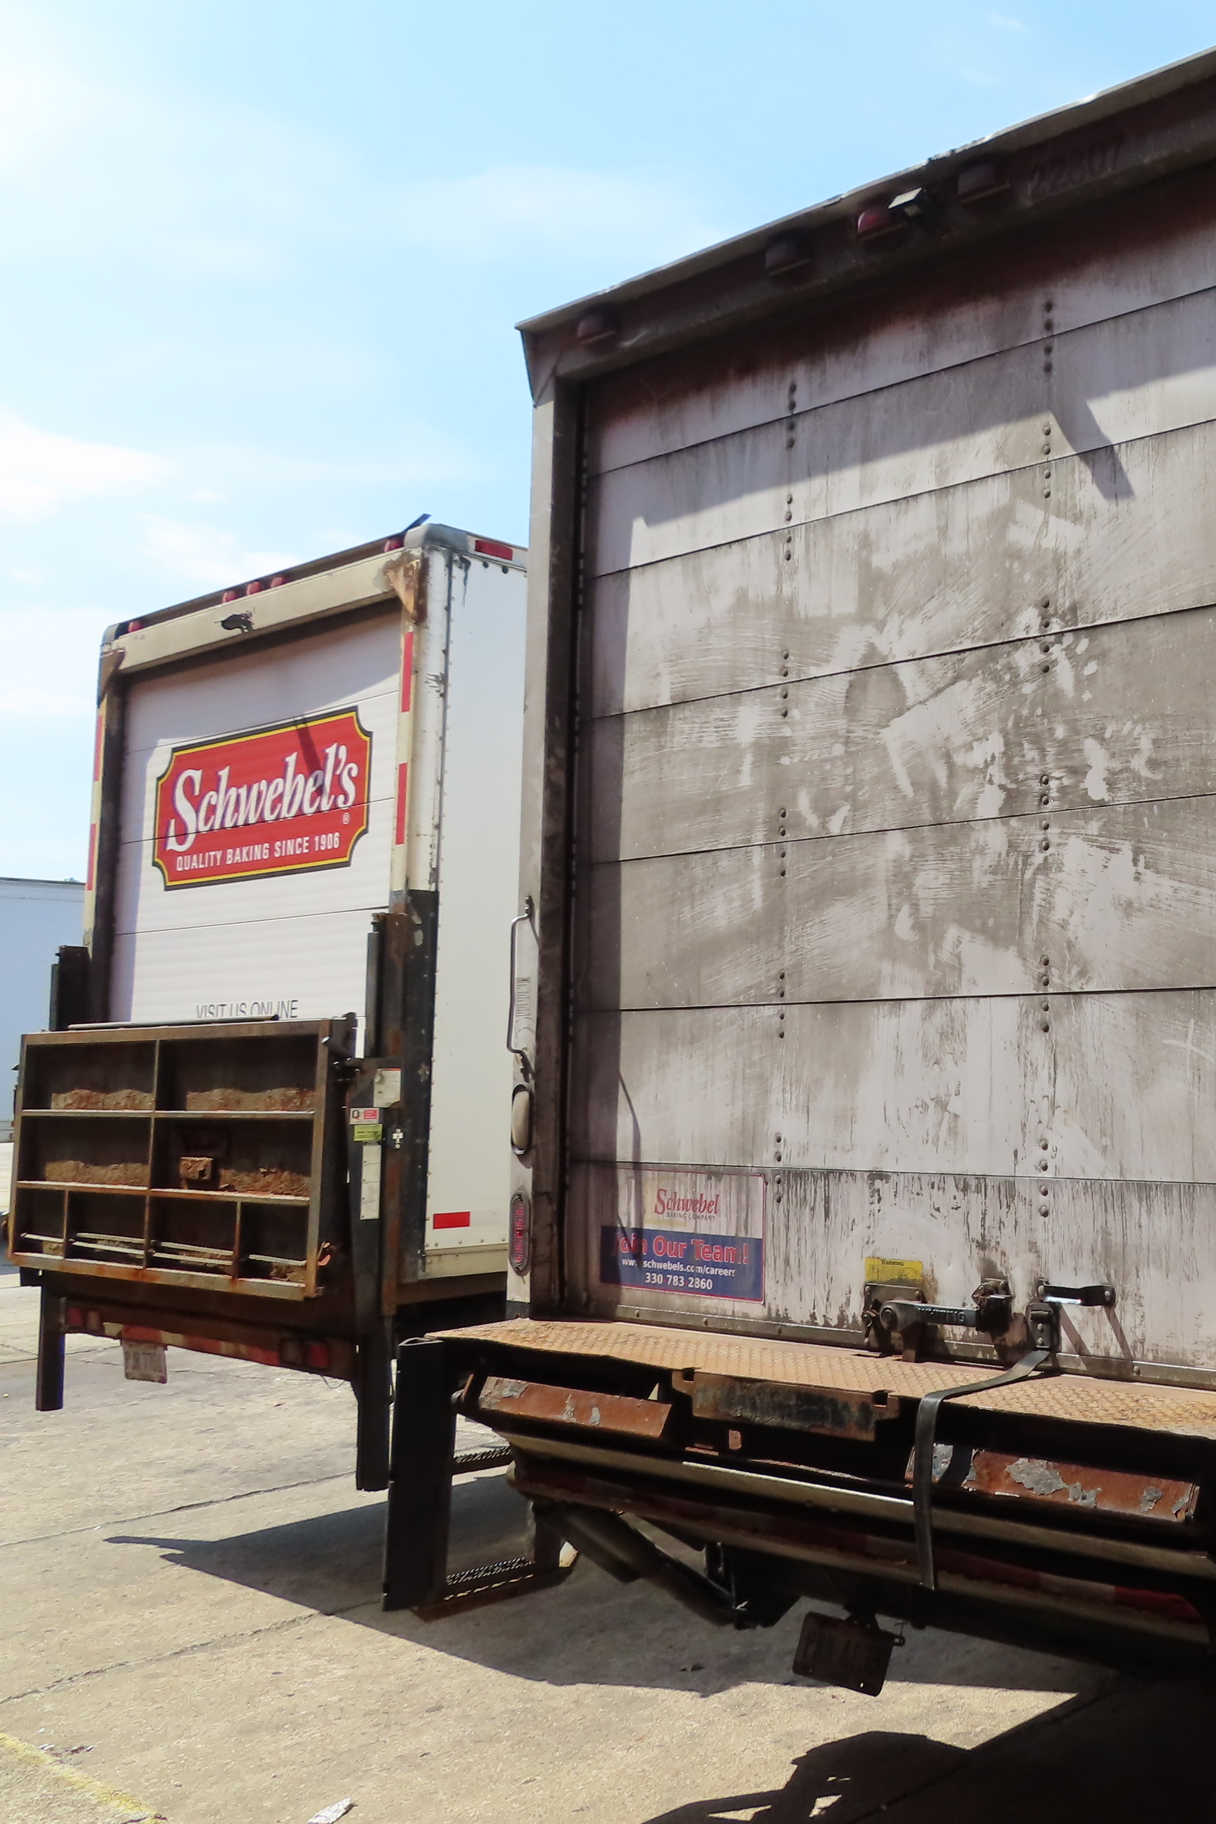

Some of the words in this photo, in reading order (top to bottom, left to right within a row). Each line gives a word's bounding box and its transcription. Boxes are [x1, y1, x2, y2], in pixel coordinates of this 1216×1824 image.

[165, 742, 359, 853] Schwebel's
[176, 852, 223, 872] QUALITY
[226, 843, 270, 865] BAKING
[274, 836, 310, 858] SINCE
[314, 832, 341, 851] 1906
[654, 1187, 720, 1216] Schwebel
[653, 1235, 688, 1260] Our
[691, 1238, 749, 1265] Team!
